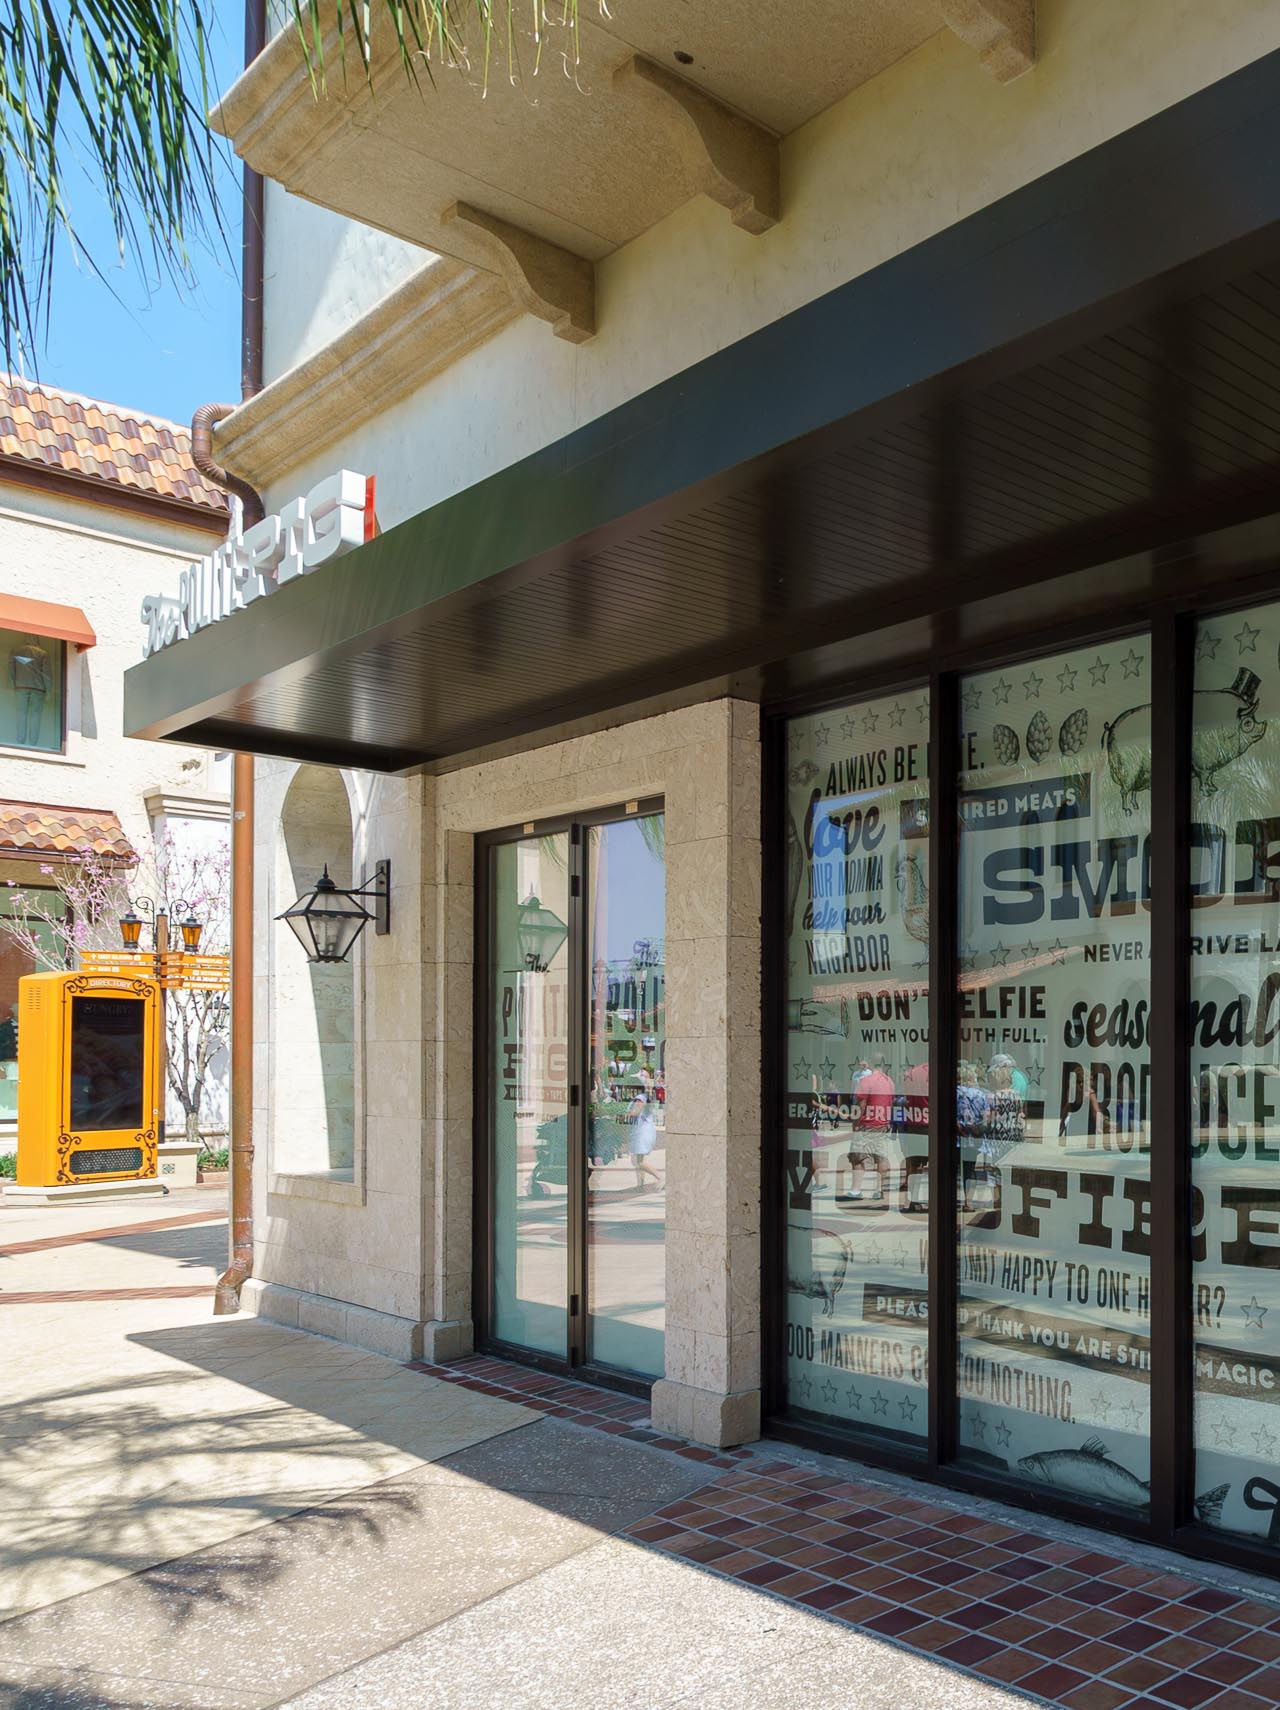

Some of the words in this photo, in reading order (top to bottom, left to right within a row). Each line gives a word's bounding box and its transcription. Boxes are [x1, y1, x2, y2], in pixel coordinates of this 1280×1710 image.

[242, 468, 366, 605] PIG
[826, 749, 887, 797] ALWAYS
[894, 744, 918, 783] BE
[804, 788, 886, 861] love
[963, 799, 1008, 820] RED
[1015, 788, 1078, 814] MEATS
[807, 863, 833, 899] YOUR
[838, 855, 884, 897] MOMMA
[803, 900, 841, 937] help
[842, 902, 887, 932] your
[805, 934, 891, 976] NEIGHBOR
[1084, 941, 1143, 963] NEVER
[960, 986, 1046, 1019] ELFIE
[861, 1029, 897, 1043] WITH
[900, 1029, 930, 1043] YOU
[961, 1028, 996, 1042] UTH
[1002, 1028, 1046, 1043] FULL.
[819, 1103, 862, 1120] GOOD
[866, 1105, 929, 1123] FRIENDS
[1002, 1252, 1058, 1299] HAPPY
[1065, 1262, 1089, 1304] TO
[1097, 1268, 1131, 1313] ONE
[876, 1296, 929, 1319] PLEAS
[973, 1311, 1025, 1341] THANK
[1029, 1326, 1070, 1350] YOU
[1075, 1335, 1112, 1360] ARE
[1196, 1359, 1275, 1389] MAGIC
[786, 1323, 815, 1362] OOD
[821, 1329, 904, 1379] MANNERS
[964, 1356, 985, 1397] OU
[991, 1362, 1076, 1424] NOTHING.
